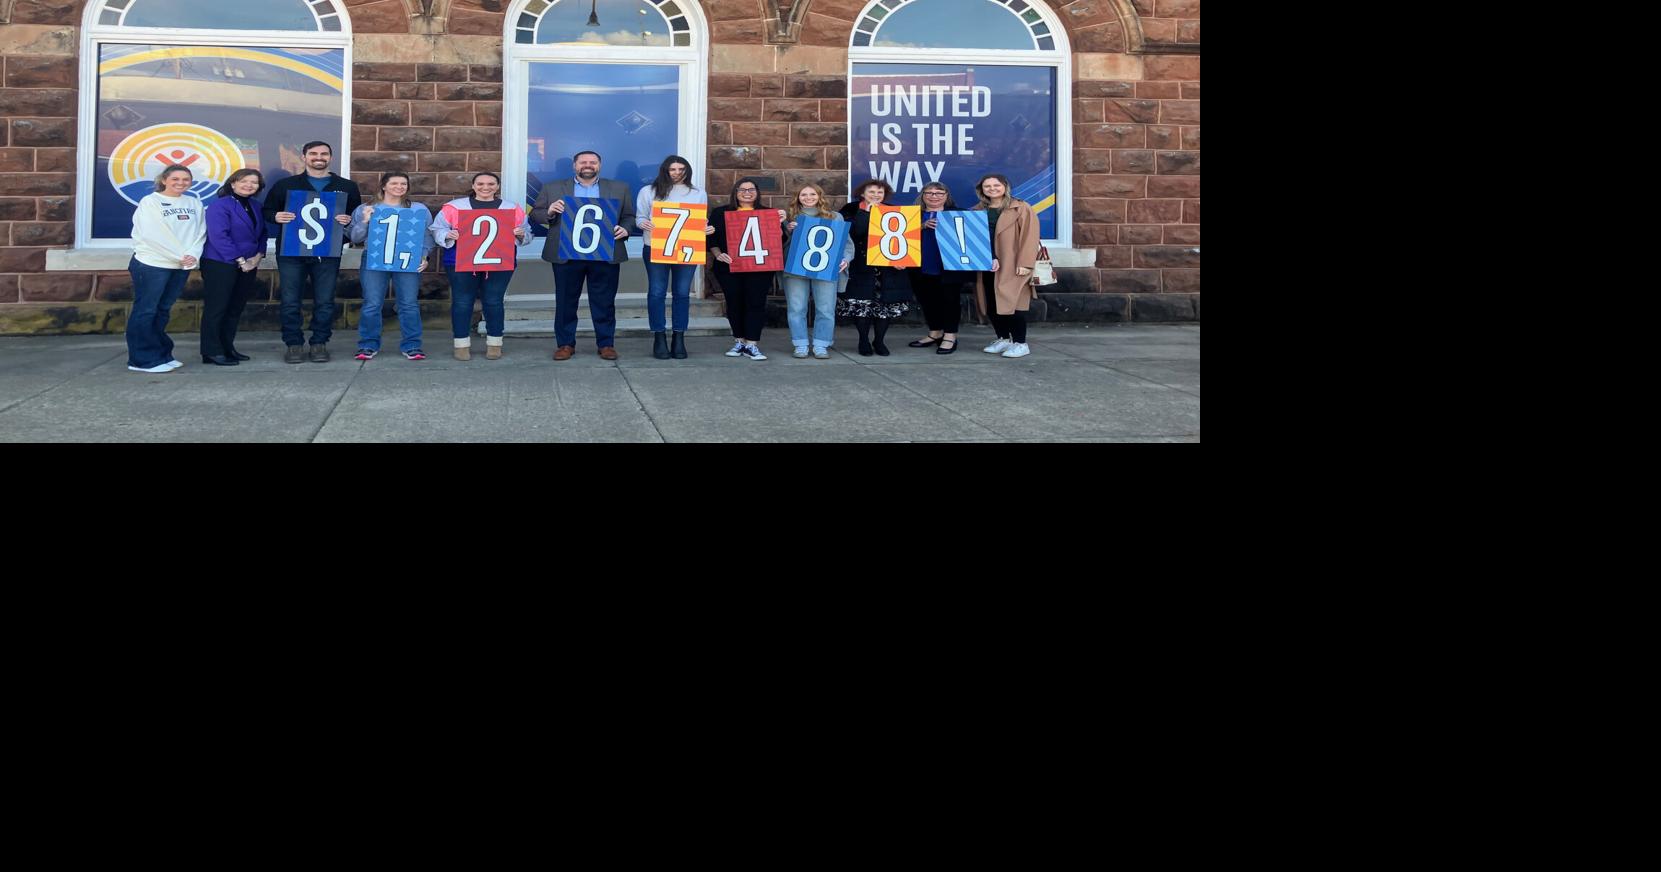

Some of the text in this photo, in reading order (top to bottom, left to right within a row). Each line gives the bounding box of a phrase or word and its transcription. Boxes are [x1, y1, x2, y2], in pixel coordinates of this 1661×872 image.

[871, 84, 991, 117] UNITED
[870, 123, 974, 155] IS THE
[869, 161, 945, 193] WAY
[472, 215, 502, 264] 2
[572, 204, 603, 254] 6
[738, 216, 769, 265] 4
[802, 225, 834, 272] 8
[879, 211, 908, 261] 8
